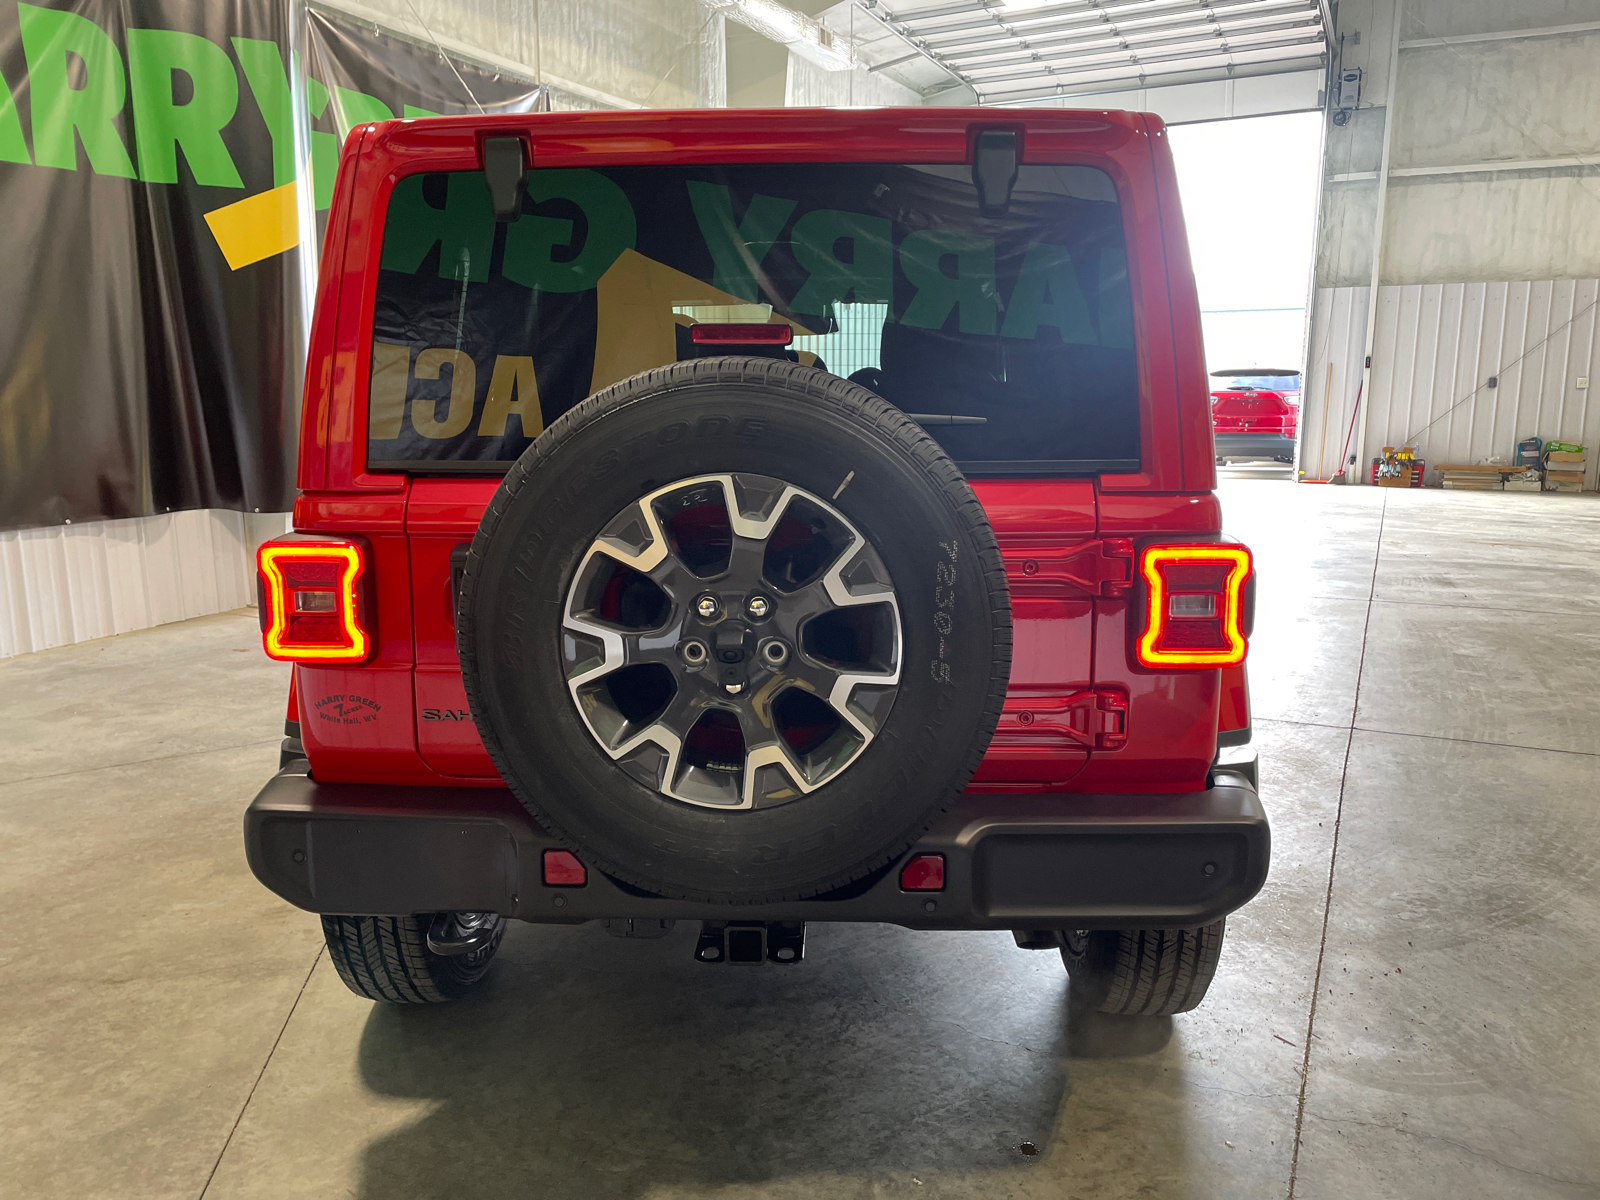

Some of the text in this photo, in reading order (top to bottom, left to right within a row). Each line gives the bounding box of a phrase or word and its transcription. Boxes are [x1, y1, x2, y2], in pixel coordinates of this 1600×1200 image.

[500, 413, 768, 674] BRIDGESTONE
[314, 694, 381, 712] HARRY GREEN
[333, 703, 345, 717] 7
[344, 704, 363, 716] ACRES
[319, 711, 341, 724] White
[363, 713, 377, 722] WV
